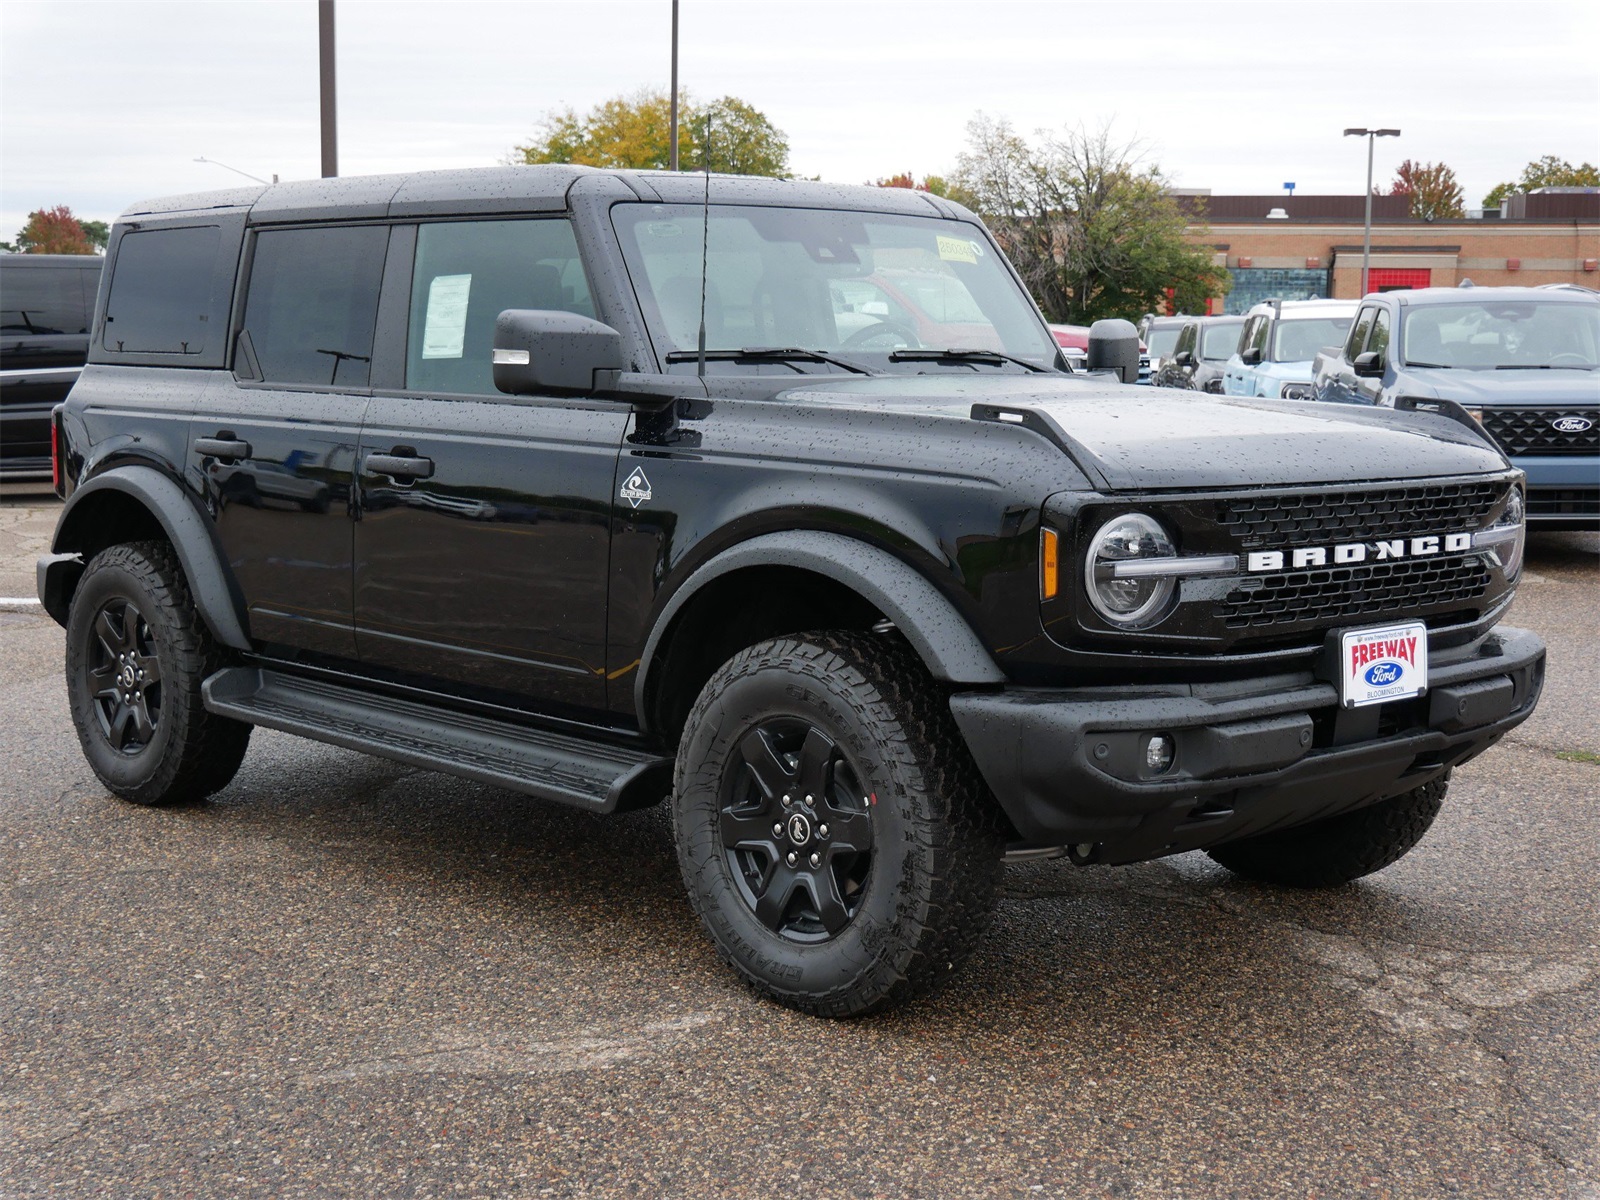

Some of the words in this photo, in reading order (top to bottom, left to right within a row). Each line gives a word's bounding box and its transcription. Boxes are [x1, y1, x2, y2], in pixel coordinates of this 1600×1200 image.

[1248, 533, 1471, 571] BRONCO
[1351, 637, 1417, 680] FREEWAY
[1371, 665, 1397, 683] Ford
[1366, 686, 1405, 699] BLOOMINGTON
[784, 683, 885, 788] GENERAL
